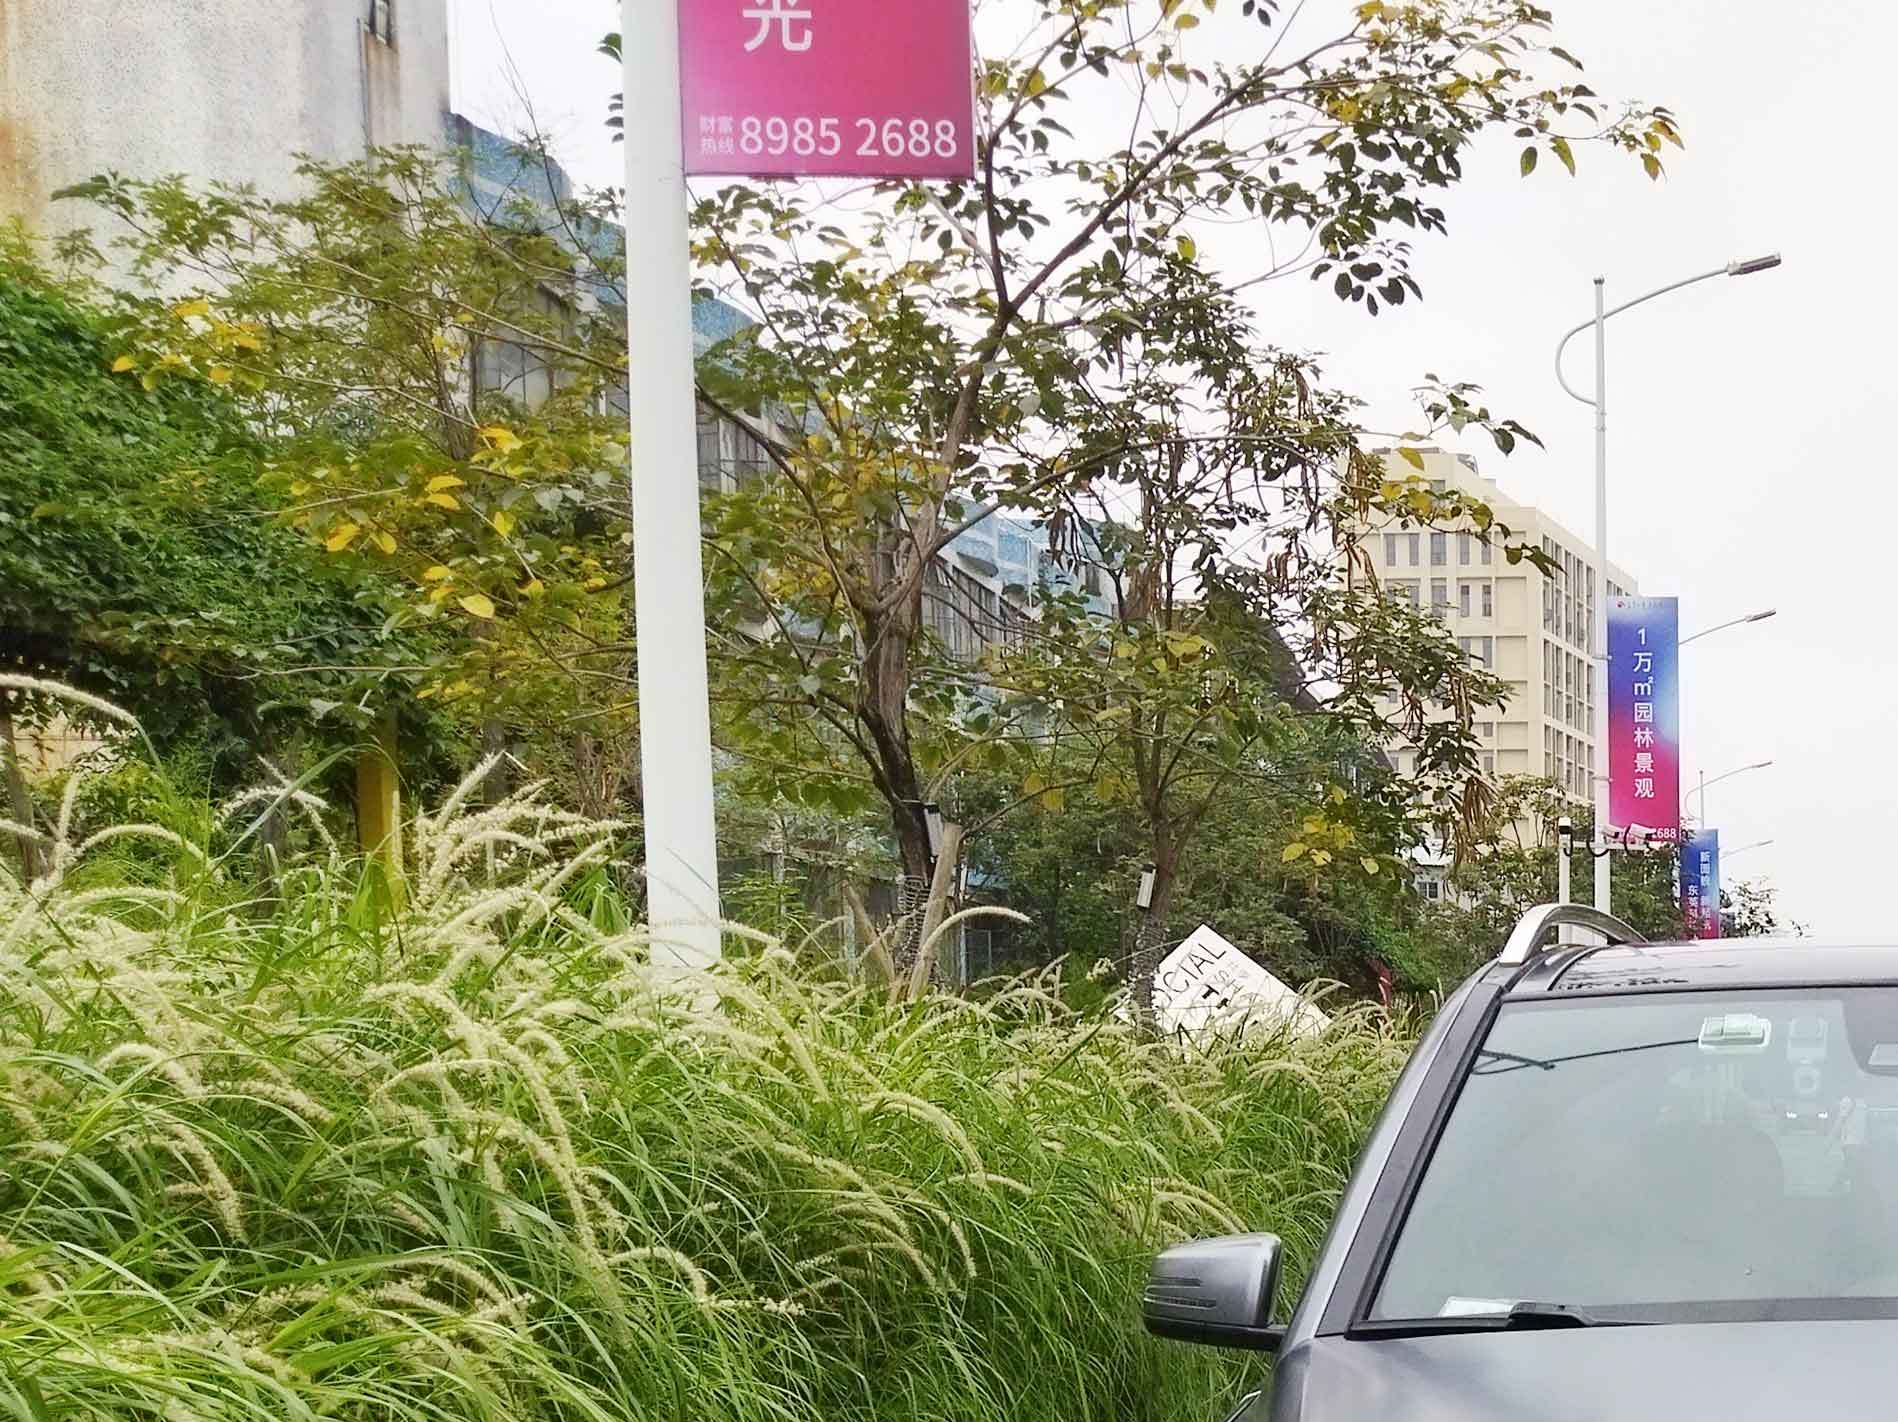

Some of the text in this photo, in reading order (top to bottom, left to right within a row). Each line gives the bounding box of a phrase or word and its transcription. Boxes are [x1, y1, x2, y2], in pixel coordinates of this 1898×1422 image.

[743, 0, 814, 52] 光
[740, 116, 958, 158] 8985 2688
